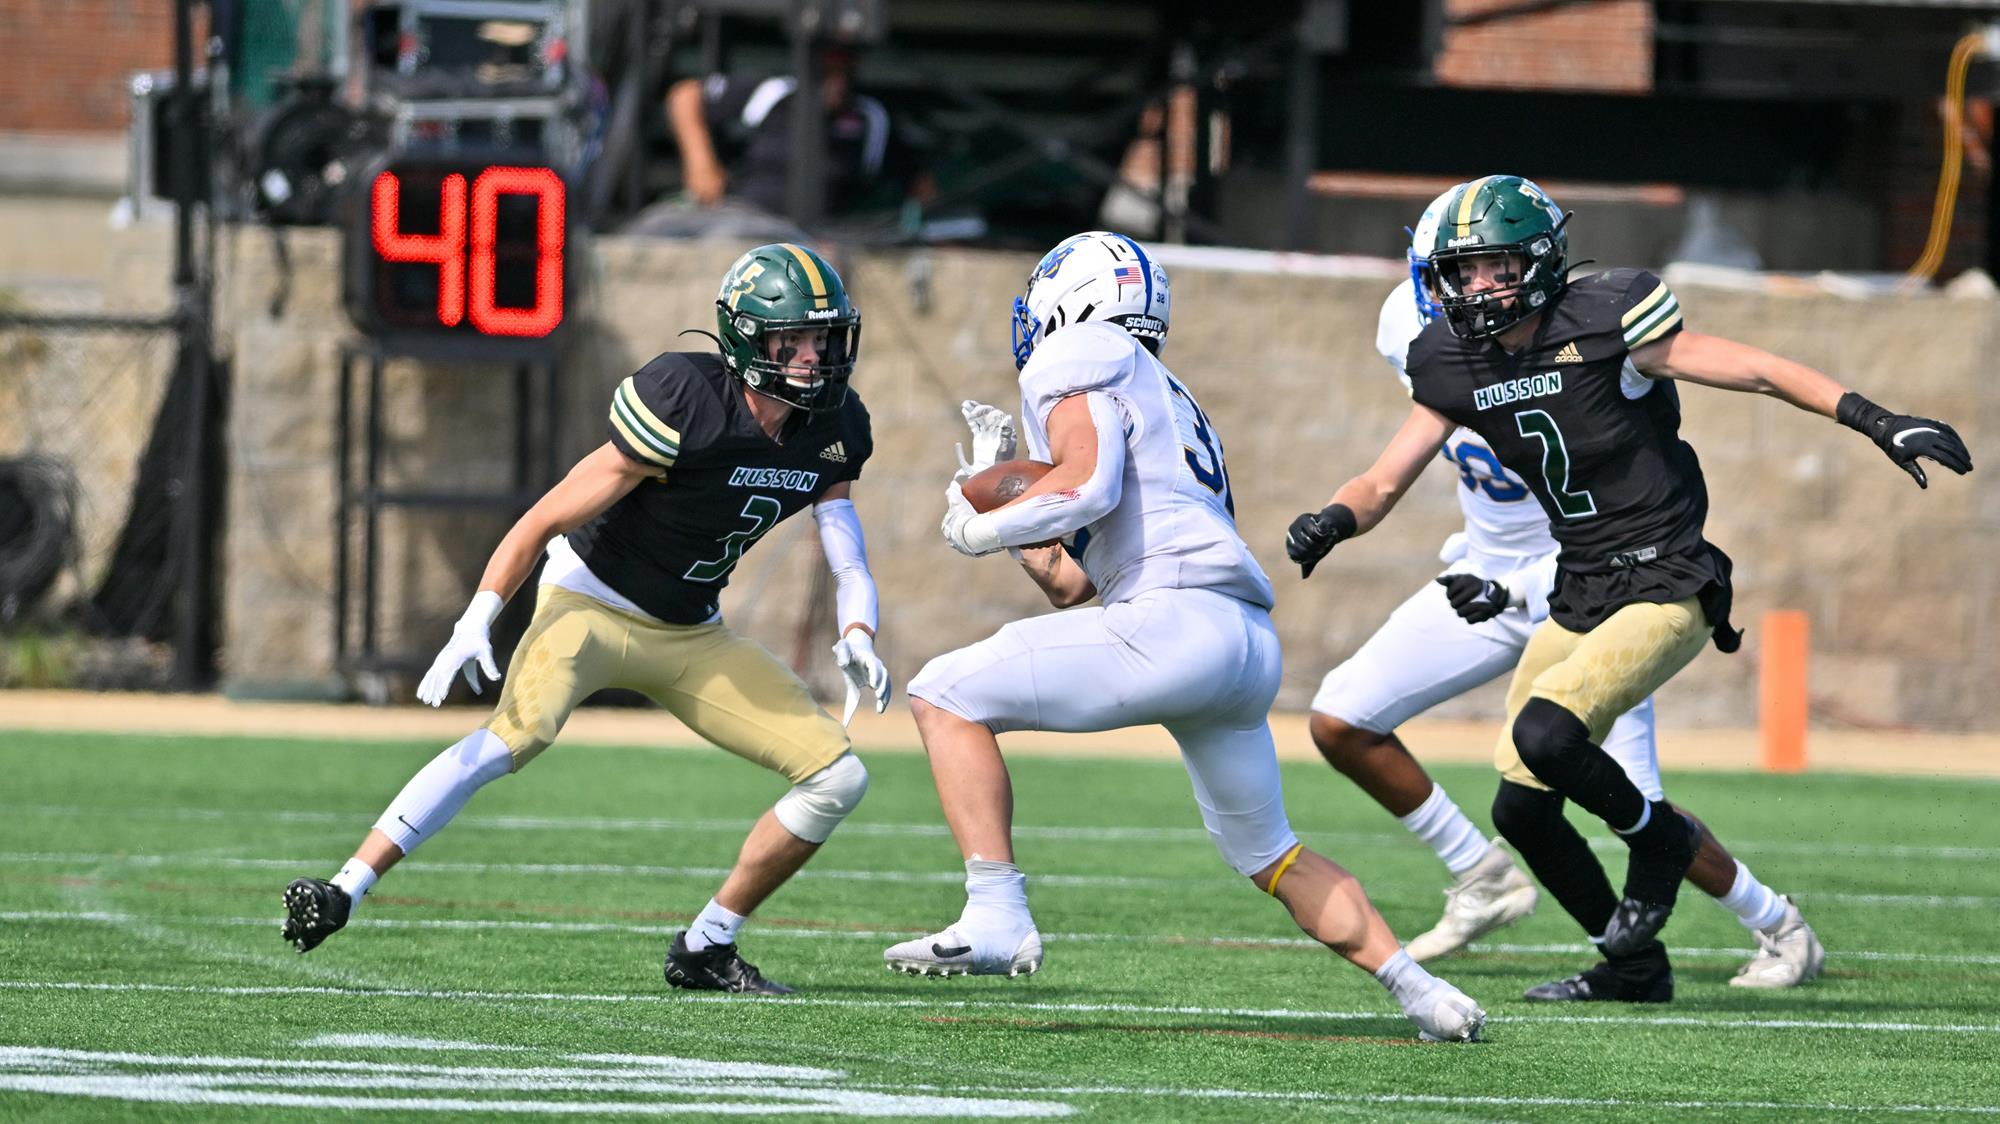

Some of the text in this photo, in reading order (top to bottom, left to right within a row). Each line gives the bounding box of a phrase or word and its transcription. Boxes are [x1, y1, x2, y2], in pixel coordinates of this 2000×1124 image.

[372, 166, 565, 338] 40
[808, 309, 839, 320] Riddell
[1554, 355, 1584, 363] adidas
[1473, 371, 1562, 411] HUSSON
[819, 451, 848, 464] adidas
[1514, 409, 1597, 518] 2
[728, 466, 819, 492] HUSSON
